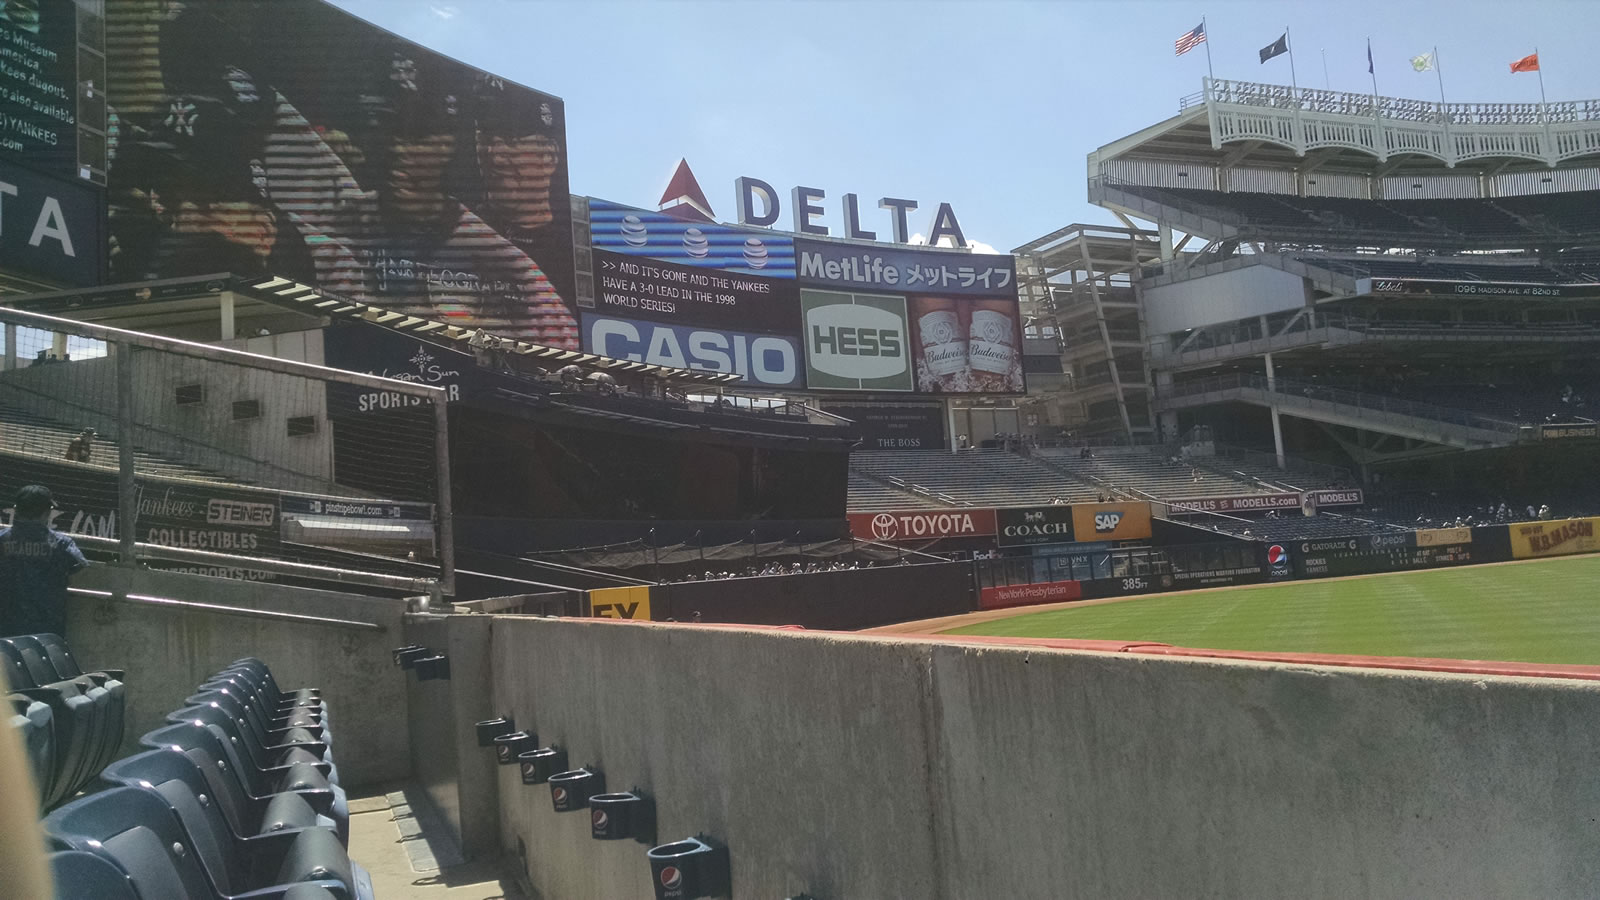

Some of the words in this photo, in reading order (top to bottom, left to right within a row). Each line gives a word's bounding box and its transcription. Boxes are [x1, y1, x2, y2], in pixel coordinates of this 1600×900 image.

[13, 30, 58, 63] Museum
[0, 47, 42, 74] merica,
[28, 73, 70, 100] dugout.
[10, 89, 31, 107] also
[32, 101, 75, 124] available
[9, 115, 58, 146] YANKEES
[734, 175, 968, 249] DELTA
[619, 262, 640, 275] AND
[641, 267, 660, 279] IT'S
[661, 269, 687, 283] GONE
[689, 274, 709, 286] AND
[711, 277, 729, 289] THE
[730, 280, 770, 294] YANKEES
[800, 251, 900, 285] MetLife
[906, 263, 1012, 289] メットライフ
[602, 276, 628, 290] HAVE
[630, 282, 637, 292] A
[639, 283, 654, 295] 3-0
[656, 285, 680, 298] LEAD
[681, 289, 692, 300] IN
[694, 291, 713, 303] THE
[715, 294, 736, 306] 1998
[603, 292, 638, 308] WORLD
[640, 298, 676, 313] SERIES!
[1454, 285, 1476, 294] 1096
[1478, 287, 1507, 295] MADISON
[1532, 288, 1551, 296] 82ND
[591, 318, 796, 385] CASIO
[813, 325, 900, 357] HESS
[427, 365, 460, 382] Sun
[877, 438, 896, 447] THE
[898, 438, 921, 447] BOSS
[134, 483, 195, 524] Yankees
[325, 502, 383, 516] pinstripebowl.com
[1232, 497, 1297, 508] MODELLS.com
[1319, 493, 1358, 504] MODELL'S
[209, 503, 273, 522] STEINER
[1095, 514, 1119, 530] SAP
[900, 514, 975, 536] TOYOTA
[1003, 522, 1068, 537] COACH
[148, 527, 258, 549] COLLECTIBLES
[1382, 533, 1406, 547] pepsi
